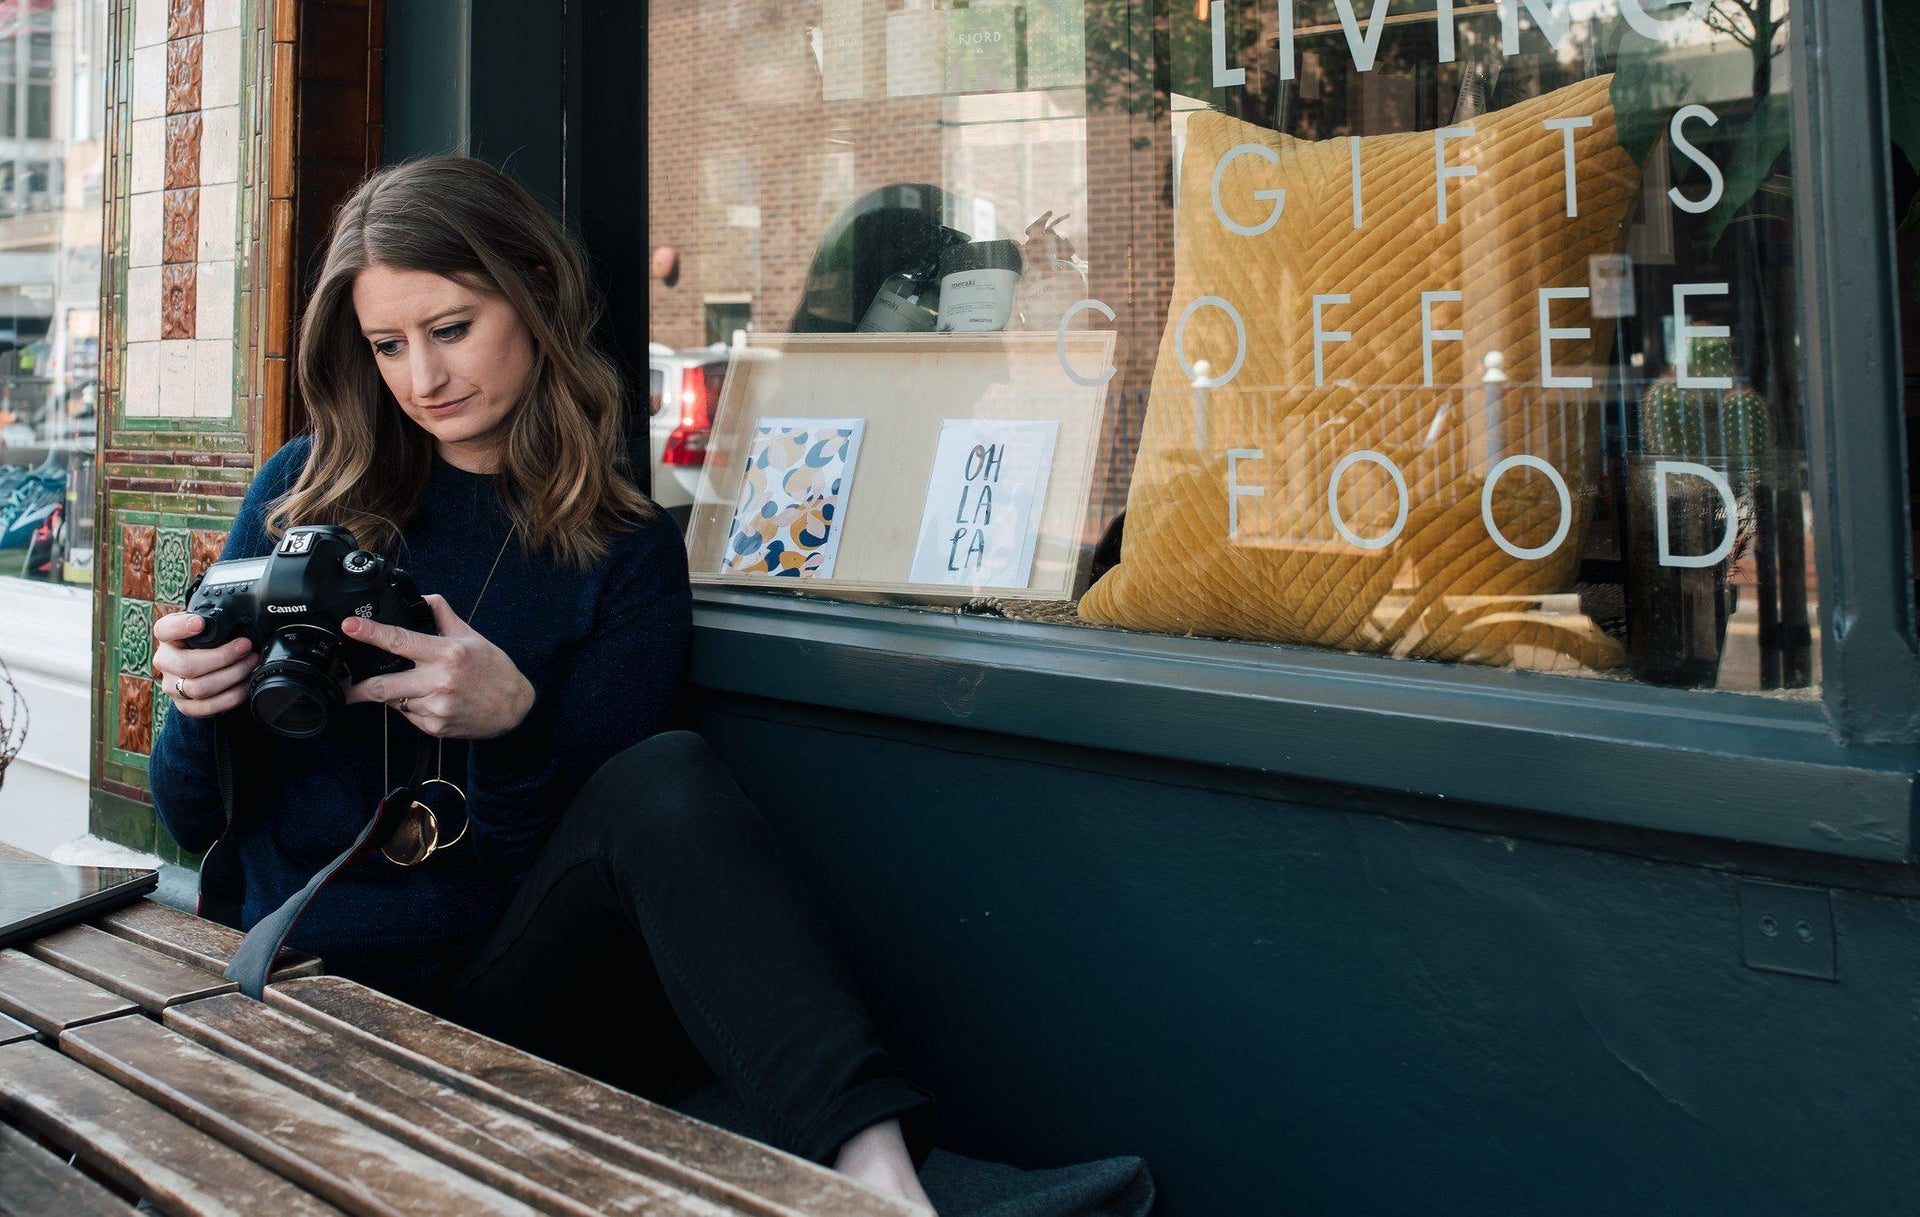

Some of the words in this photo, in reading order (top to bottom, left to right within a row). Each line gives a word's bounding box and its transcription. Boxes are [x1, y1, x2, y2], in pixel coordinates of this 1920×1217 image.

[958, 31, 1001, 45] FJORD
[1211, 104, 1724, 237] GIFTS
[1057, 283, 1733, 388] COFFEE
[965, 444, 1005, 482] OH
[956, 485, 992, 525] LA
[1228, 449, 1739, 568] FOOD
[267, 604, 307, 613] Canon
[354, 603, 373, 616] EOS
